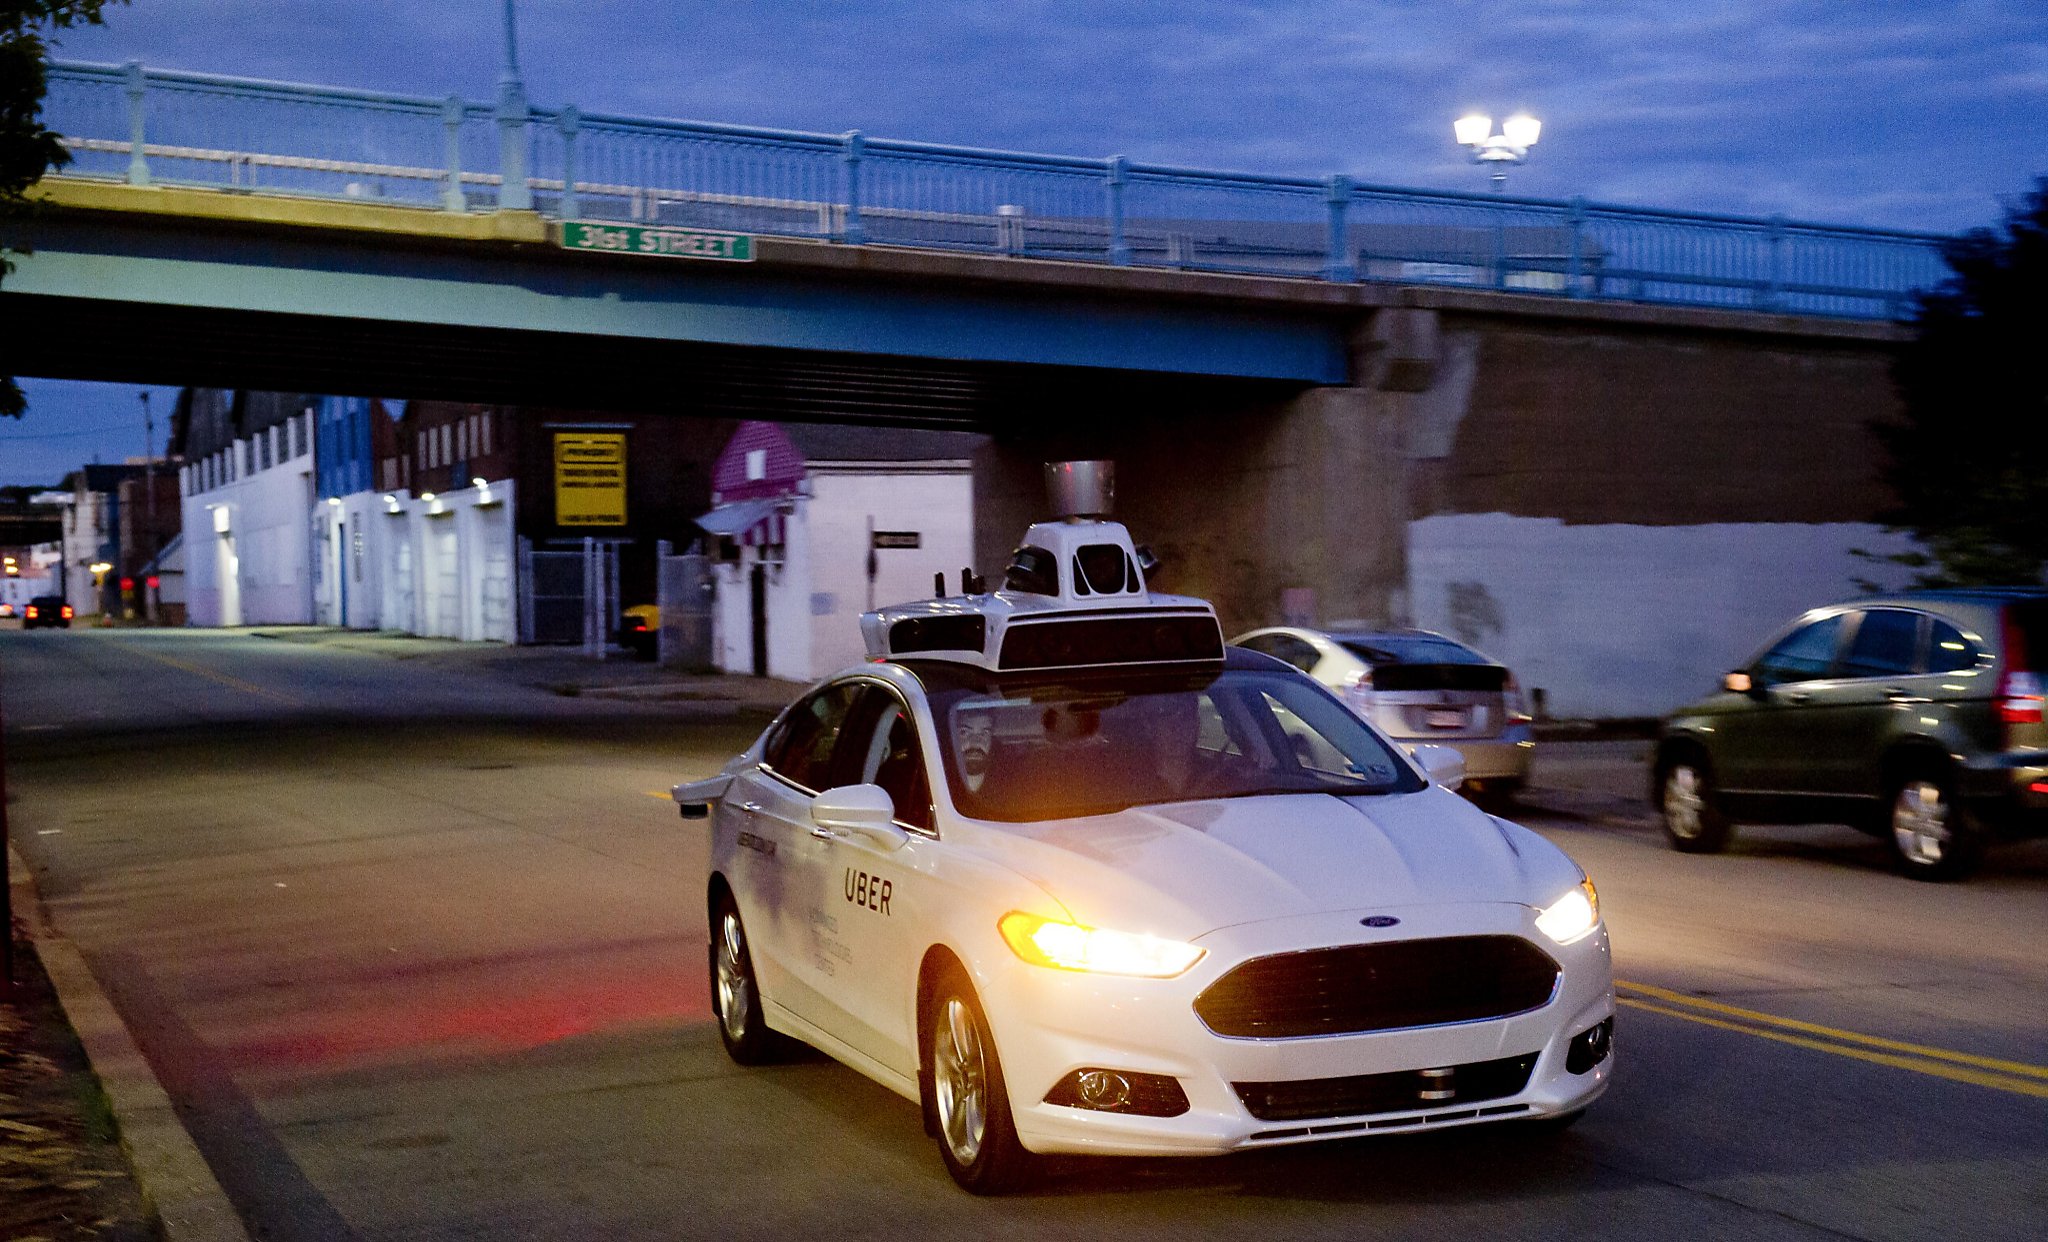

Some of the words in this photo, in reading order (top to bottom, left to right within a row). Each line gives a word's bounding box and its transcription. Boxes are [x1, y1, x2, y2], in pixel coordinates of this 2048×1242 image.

[578, 225, 628, 250] 31st
[638, 230, 737, 257] STREET
[845, 866, 893, 916] UBER
